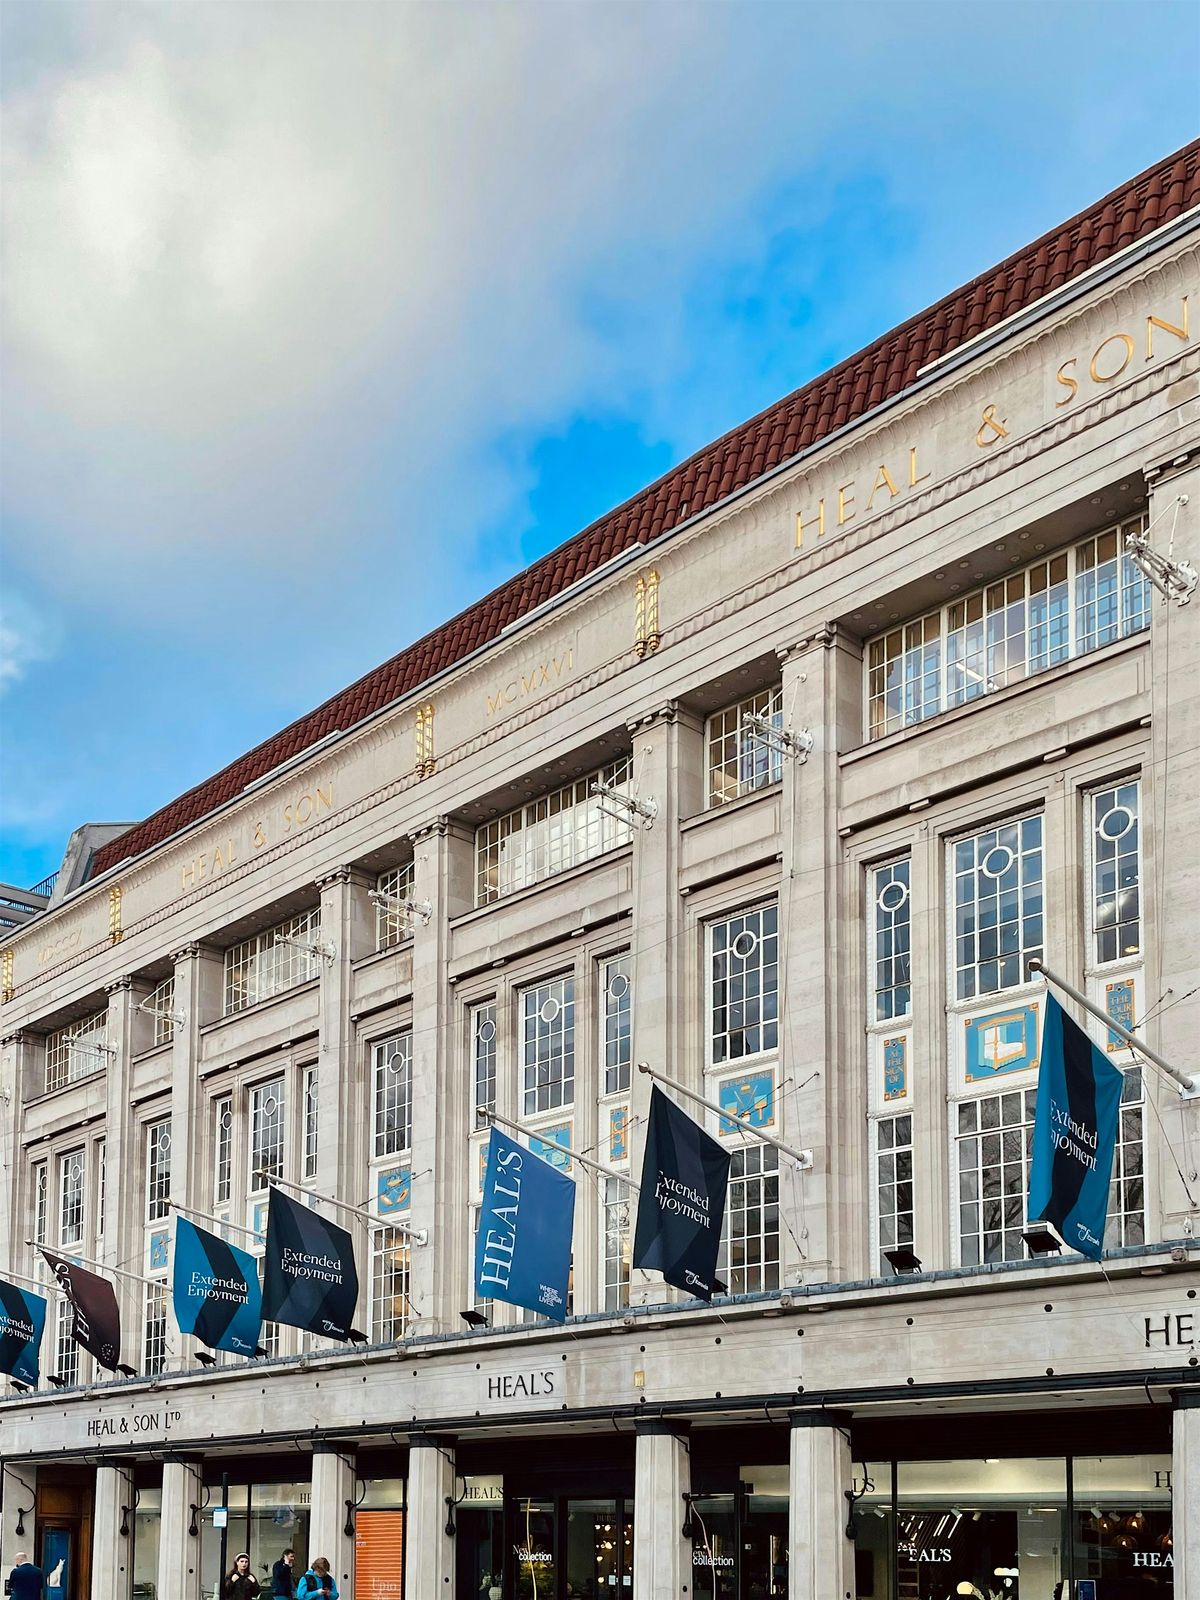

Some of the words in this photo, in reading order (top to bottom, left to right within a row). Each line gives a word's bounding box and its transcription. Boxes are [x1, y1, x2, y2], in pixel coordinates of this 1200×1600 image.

[794, 447, 931, 549] HEAL
[975, 403, 1011, 448] &
[1055, 295, 1190, 409] SON
[485, 649, 573, 716] MCMXVI
[182, 839, 237, 891] HEAL
[253, 821, 268, 849] &
[283, 781, 334, 832] SON
[1050, 1128, 1098, 1172] njoyment
[480, 1147, 523, 1290] HEAL'S
[283, 1247, 341, 1271] Extended
[191, 1271, 248, 1293] Extended
[281, 1258, 343, 1285] Enjoyment
[187, 1284, 249, 1305] Enjoyment
[0, 1315, 34, 1333] xtended
[1144, 1313, 1200, 1348] HE
[488, 1371, 554, 1399] HEAL'S
[87, 1418, 116, 1437] HEAL
[119, 1417, 129, 1434] &
[133, 1413, 159, 1432] SON
[518, 1551, 552, 1562] collection
[692, 1555, 735, 1566] collection
[909, 1548, 952, 1562] EAL'S
[1132, 1552, 1174, 1567] HEA
